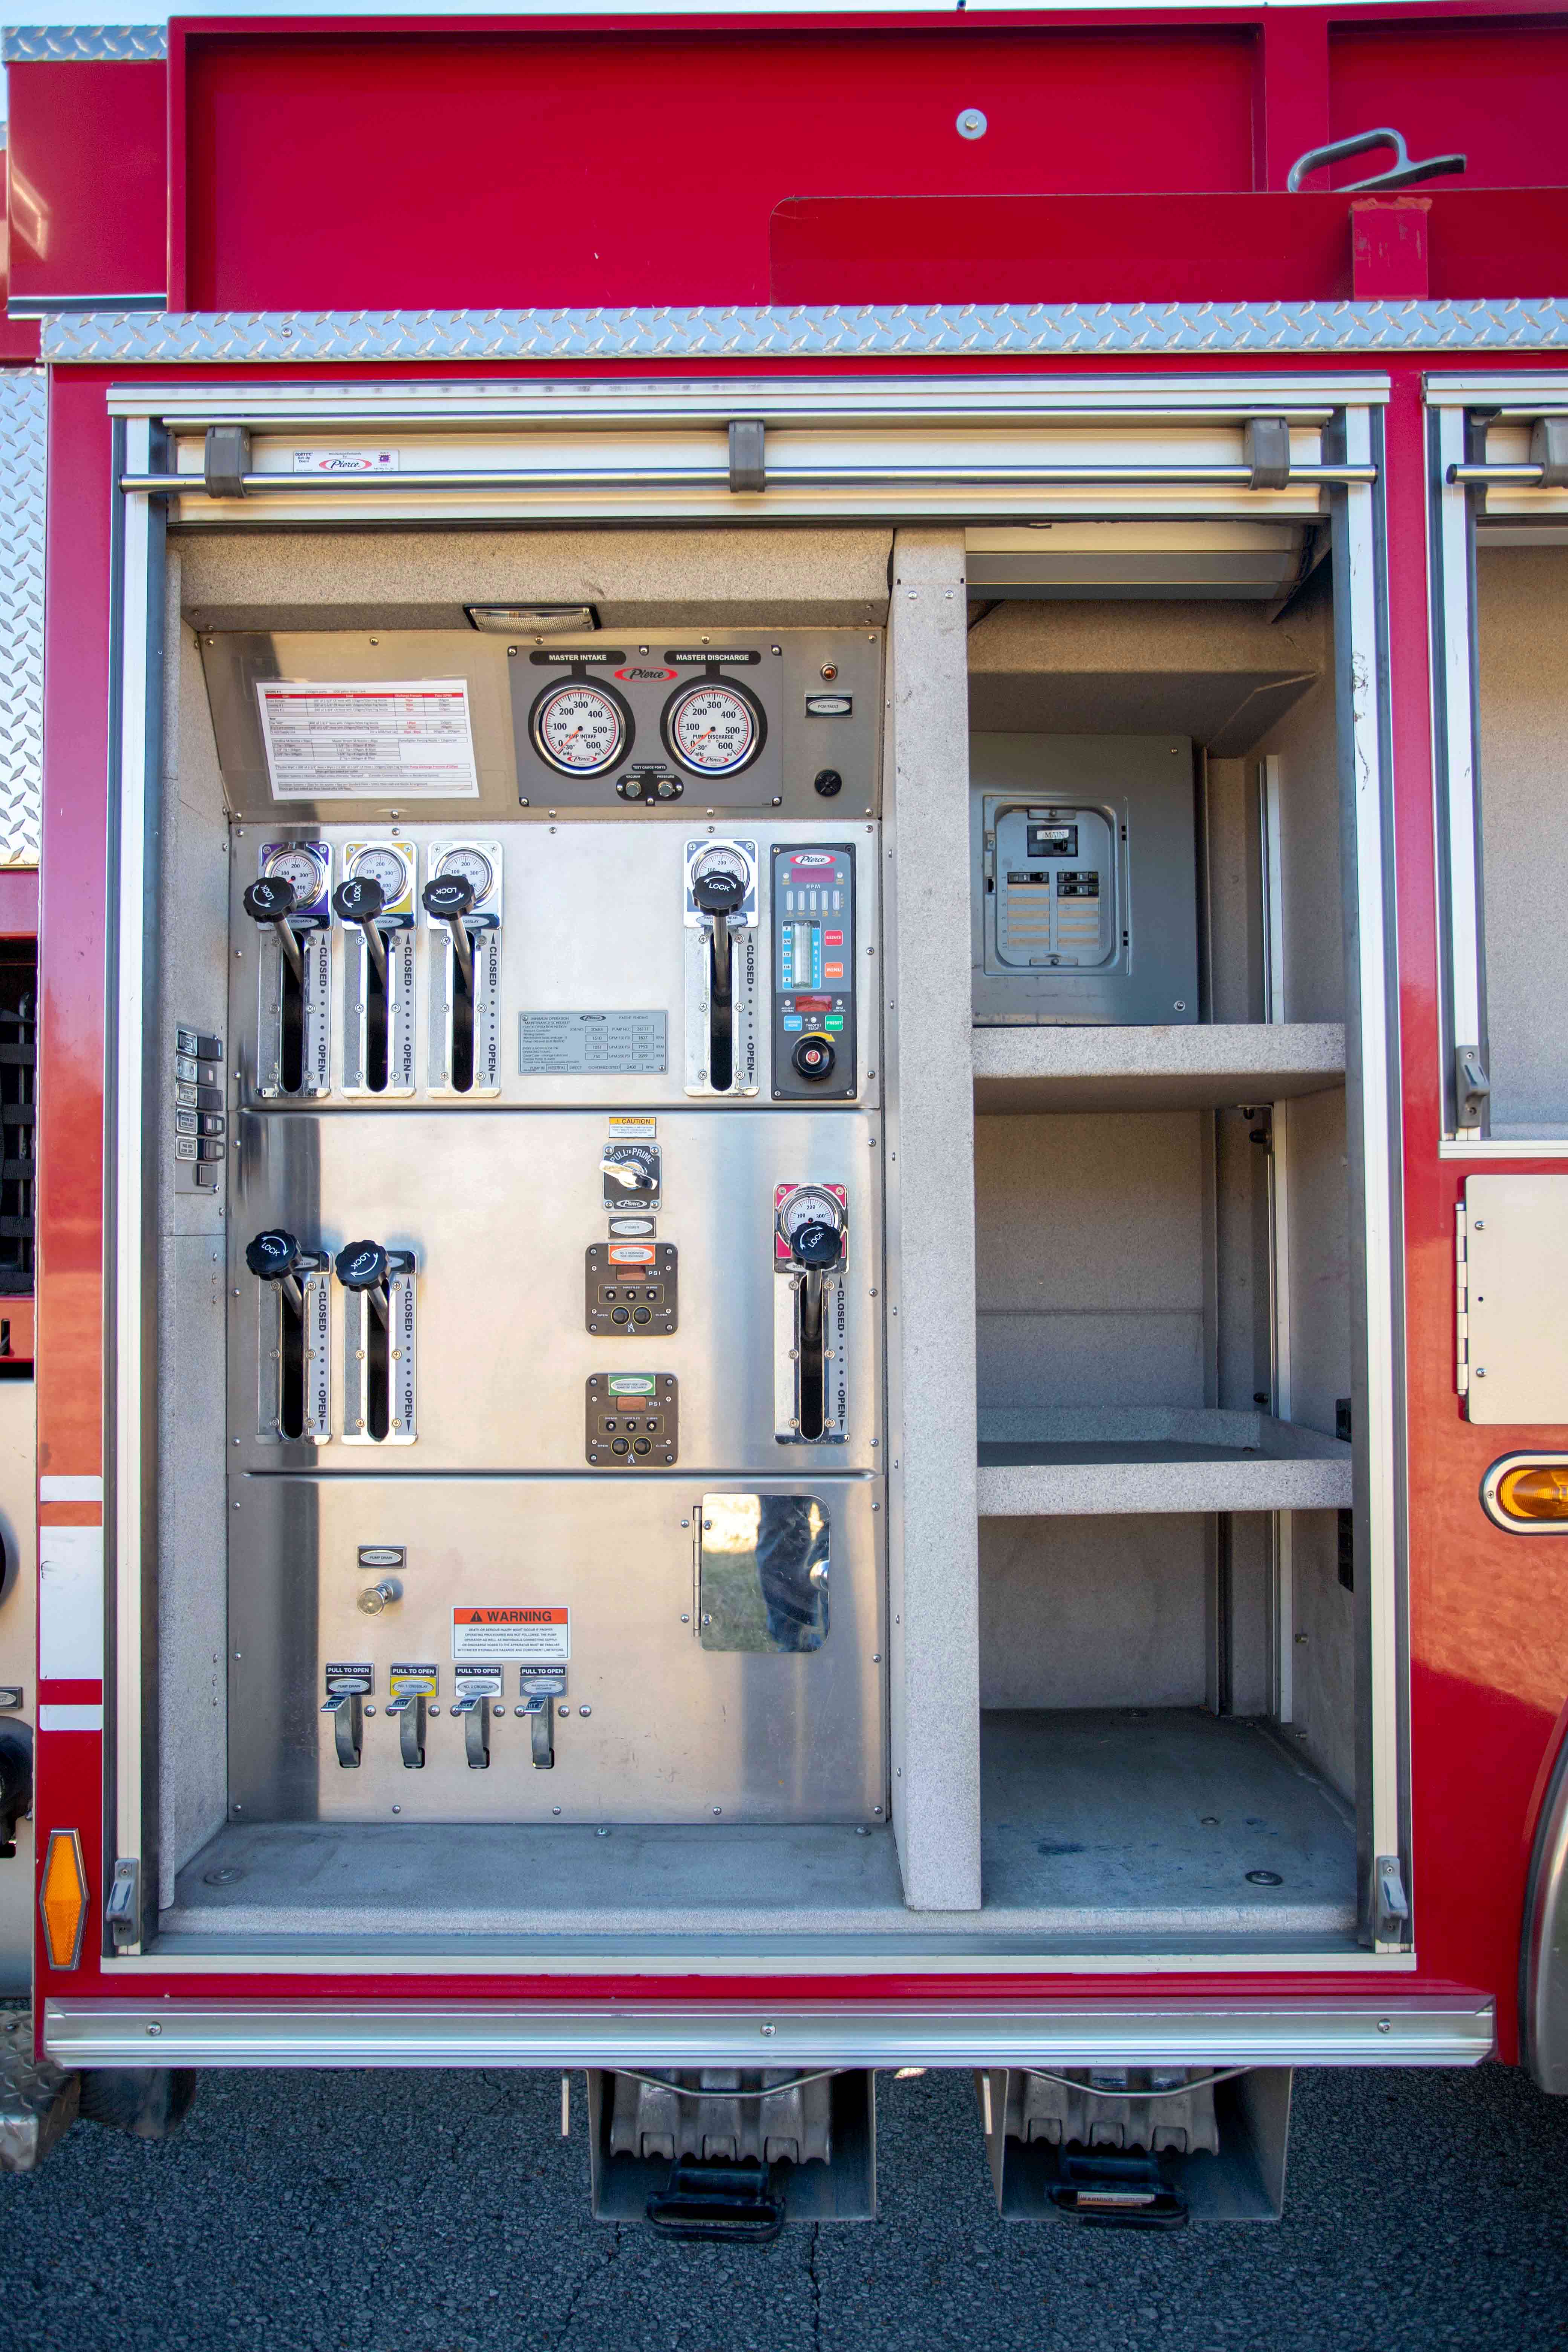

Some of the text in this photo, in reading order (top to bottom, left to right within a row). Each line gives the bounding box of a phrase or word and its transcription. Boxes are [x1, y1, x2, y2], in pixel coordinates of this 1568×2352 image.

[331, 459, 359, 469] Pierce
[629, 668, 665, 680] Pierce
[261, 885, 274, 900] LOCK
[354, 885, 362, 901] LOCK
[709, 883, 730, 892] LOCK
[318, 1044, 326, 1072] OPEN
[403, 1044, 412, 1072] OPEN
[488, 1043, 496, 1072] OPEN
[610, 1149, 628, 1162] PULL
[632, 1148, 654, 1164] PRIME
[808, 1232, 824, 1248] LOCK
[261, 1242, 280, 1257] LOCK
[351, 1252, 371, 1269] LOCK
[487, 1611, 551, 1622] WARNING
